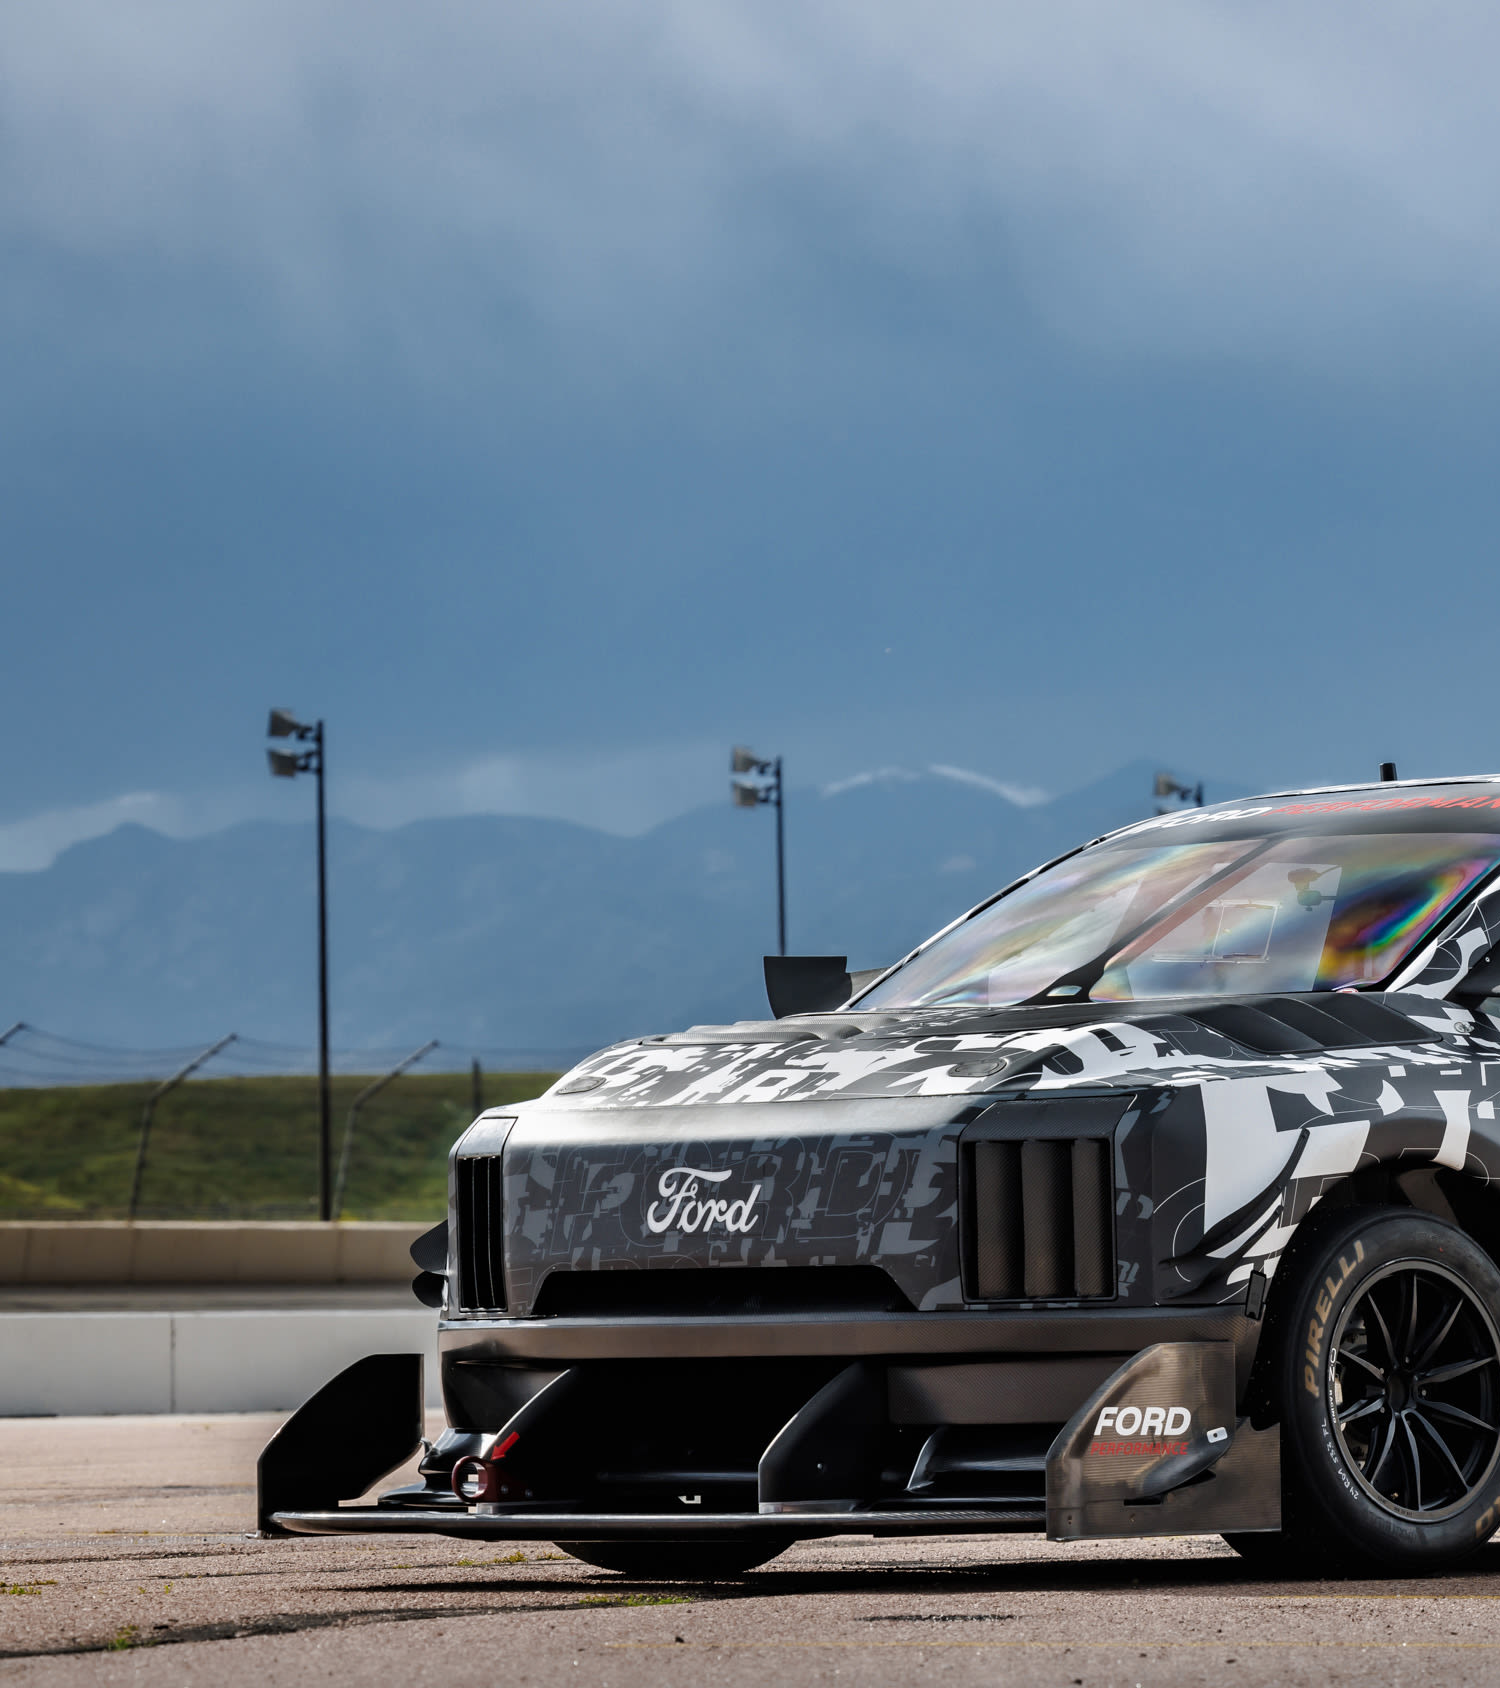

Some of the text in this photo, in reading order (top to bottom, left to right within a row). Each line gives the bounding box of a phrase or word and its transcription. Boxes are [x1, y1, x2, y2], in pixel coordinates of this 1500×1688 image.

[646, 1166, 762, 1234] Ford
[1304, 1239, 1365, 1398] PIRELLI
[1093, 1406, 1192, 1436] FORD
[1090, 1442, 1189, 1457] PERFORMANCE
